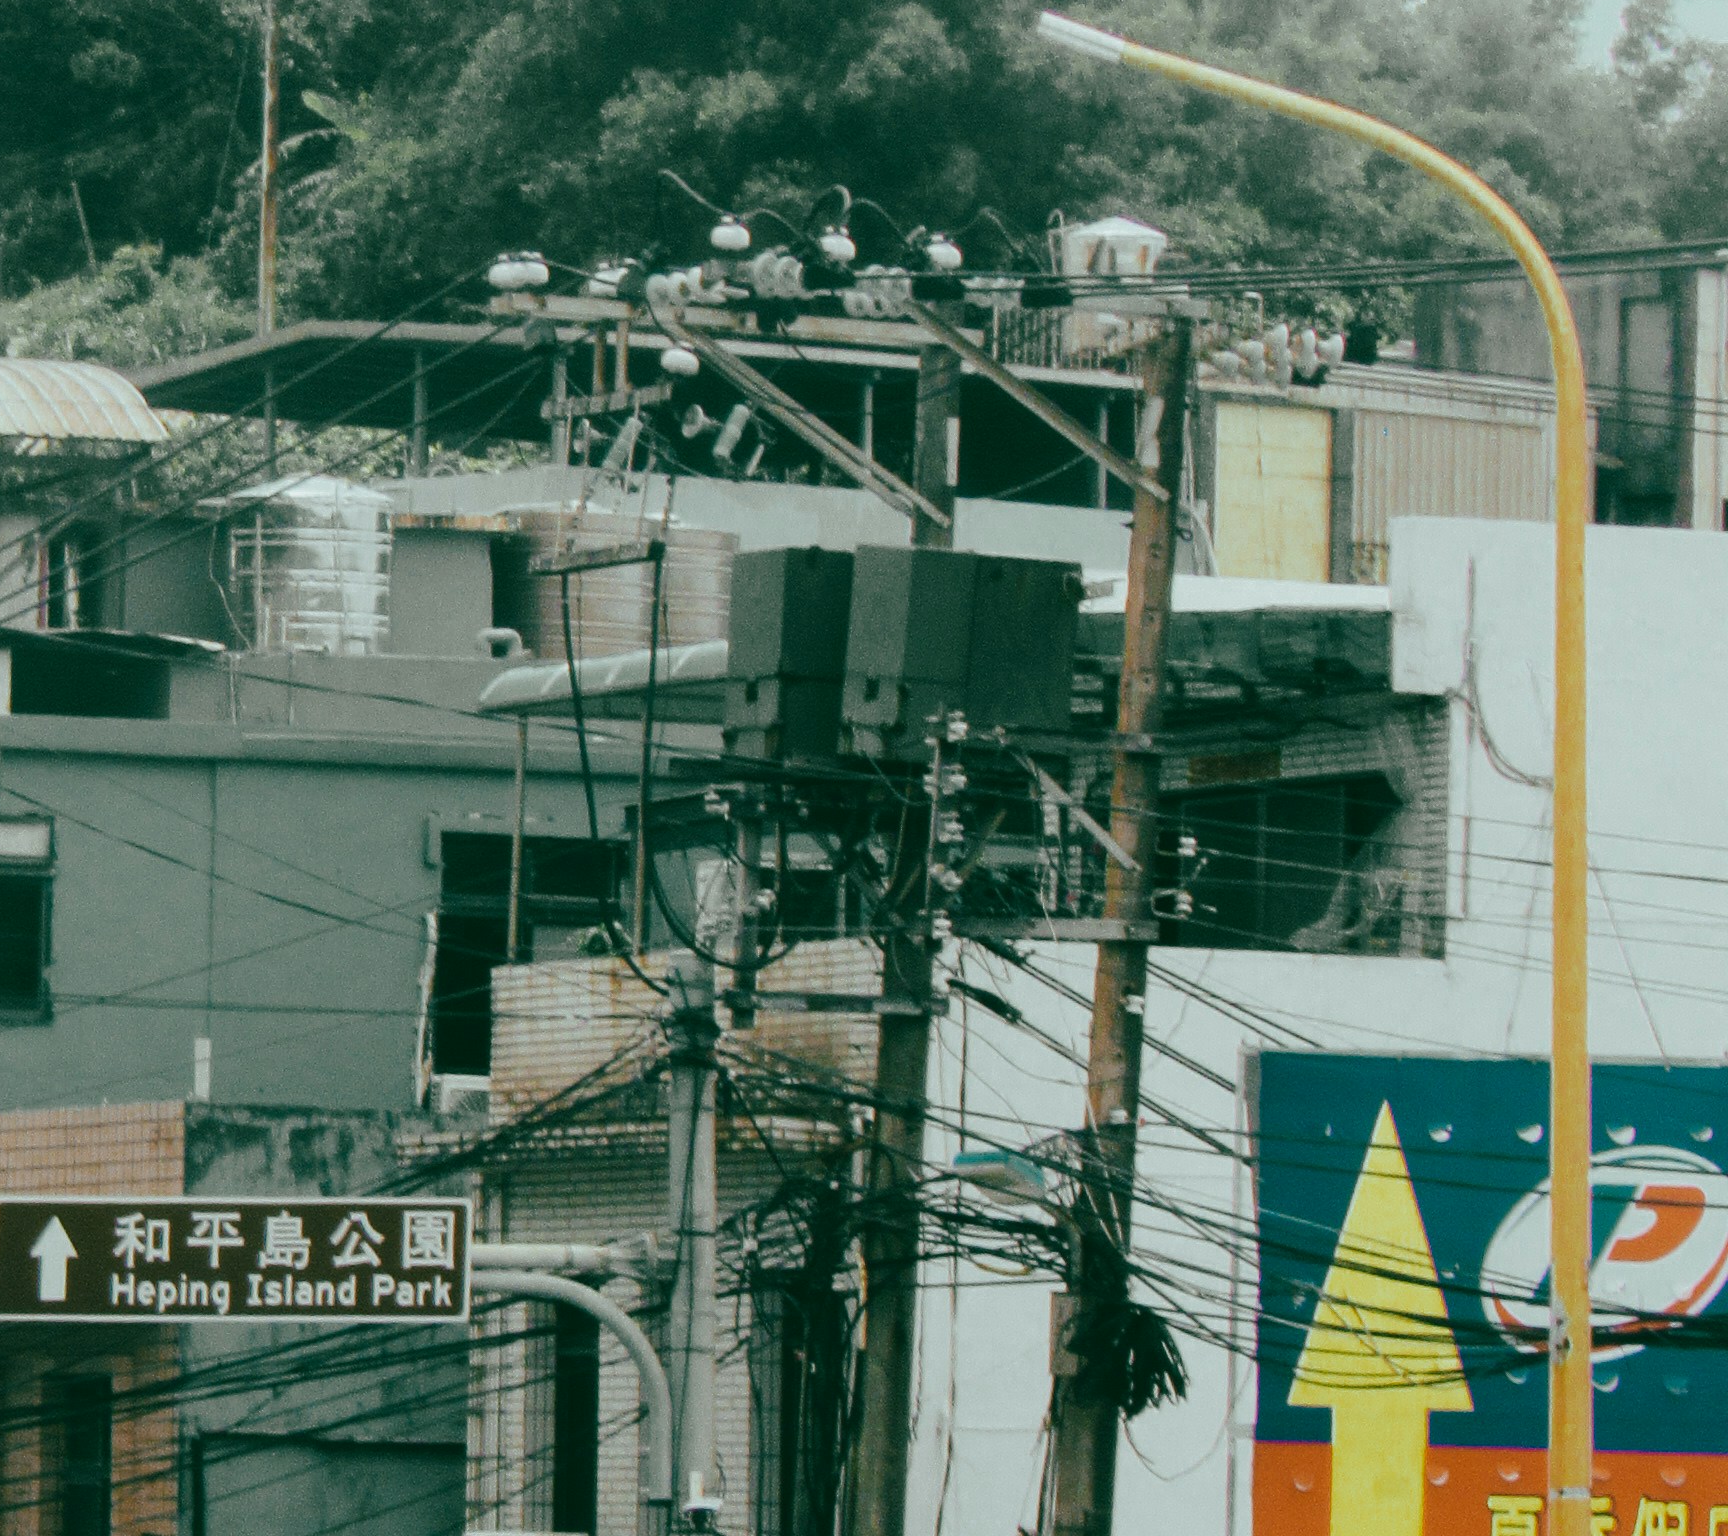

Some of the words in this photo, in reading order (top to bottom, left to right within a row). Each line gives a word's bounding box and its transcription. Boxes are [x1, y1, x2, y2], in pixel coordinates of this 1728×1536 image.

[112, 1208, 456, 1272] 和平島公園
[110, 1272, 231, 1315] Heping
[246, 1272, 357, 1308] Island
[372, 1273, 454, 1308] Park
